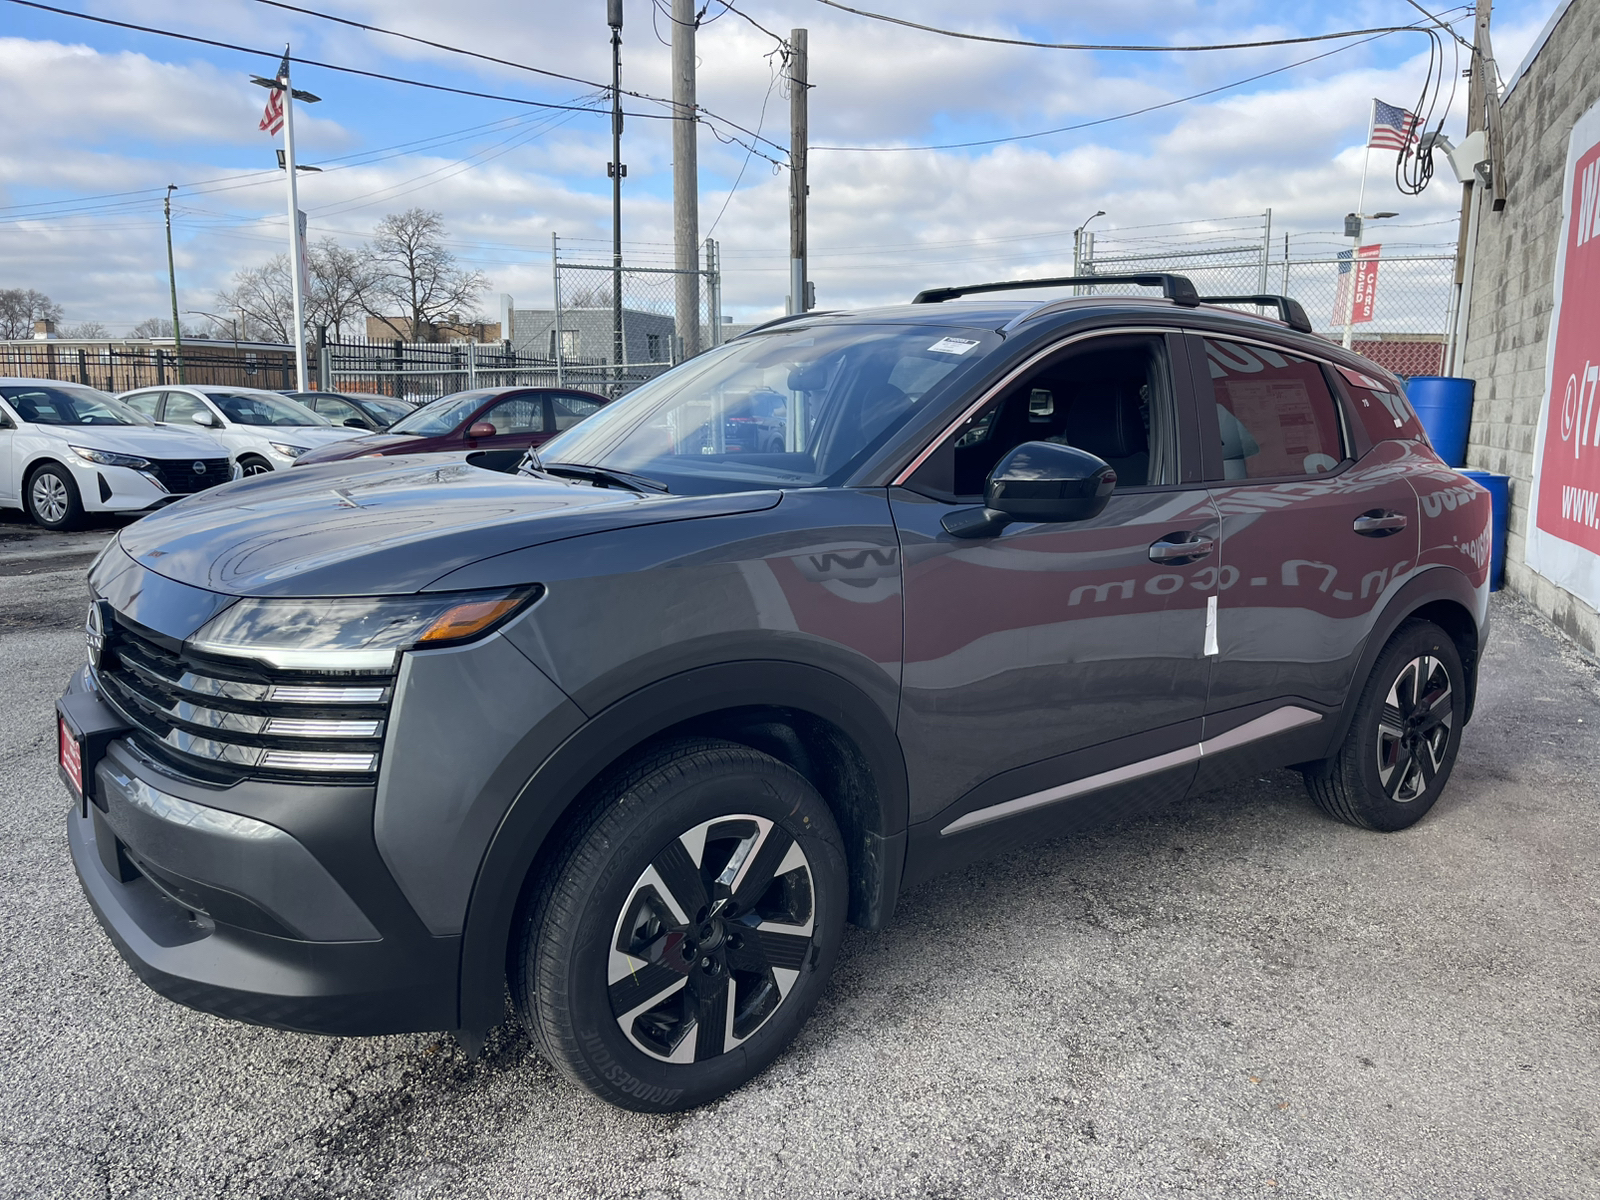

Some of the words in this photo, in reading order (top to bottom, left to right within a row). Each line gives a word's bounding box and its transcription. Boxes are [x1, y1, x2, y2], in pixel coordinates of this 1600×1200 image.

[1355, 260, 1367, 303] USED
[1363, 273, 1374, 316] CARS
[581, 1029, 683, 1106] BRIDGESTONE
